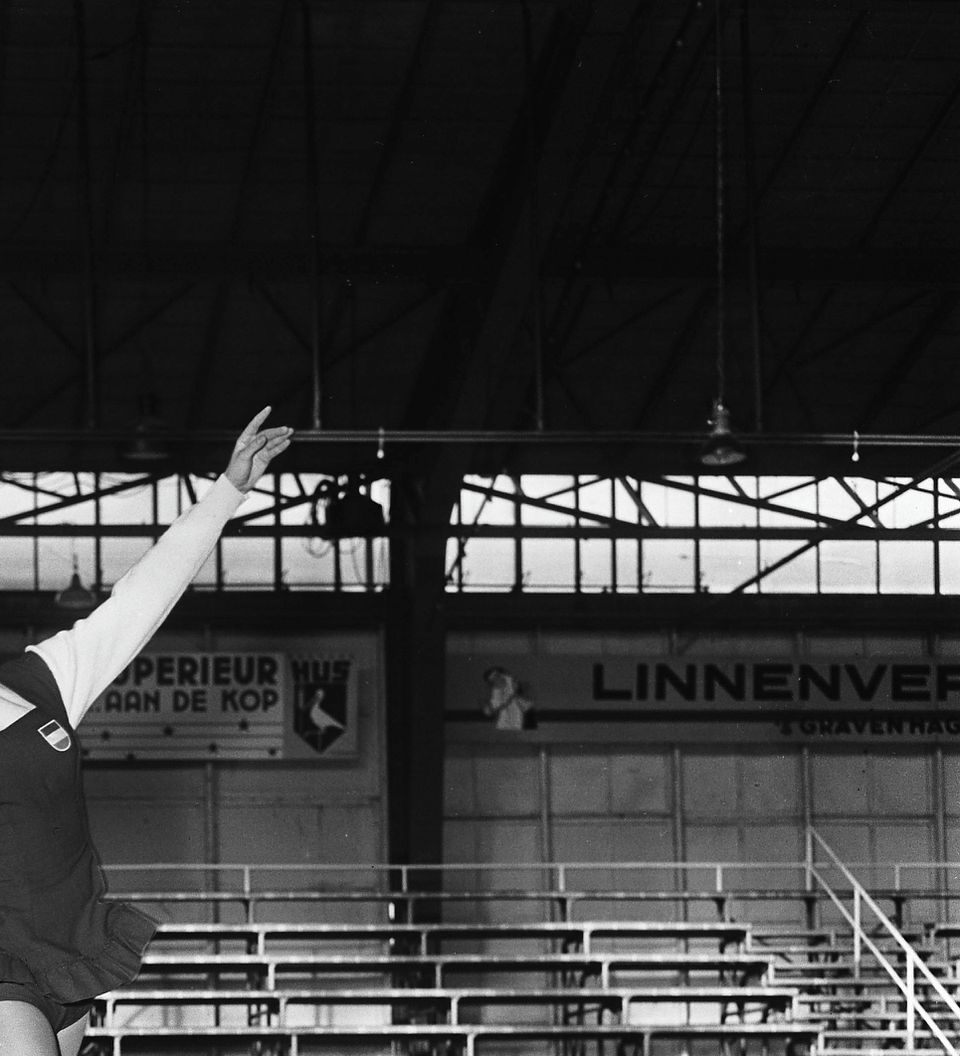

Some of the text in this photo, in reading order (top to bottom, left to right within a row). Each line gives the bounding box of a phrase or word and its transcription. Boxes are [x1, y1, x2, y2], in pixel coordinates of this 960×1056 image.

[291, 659, 351, 681] HUS
[172, 690, 207, 712] DE
[222, 690, 279, 712] KOP
